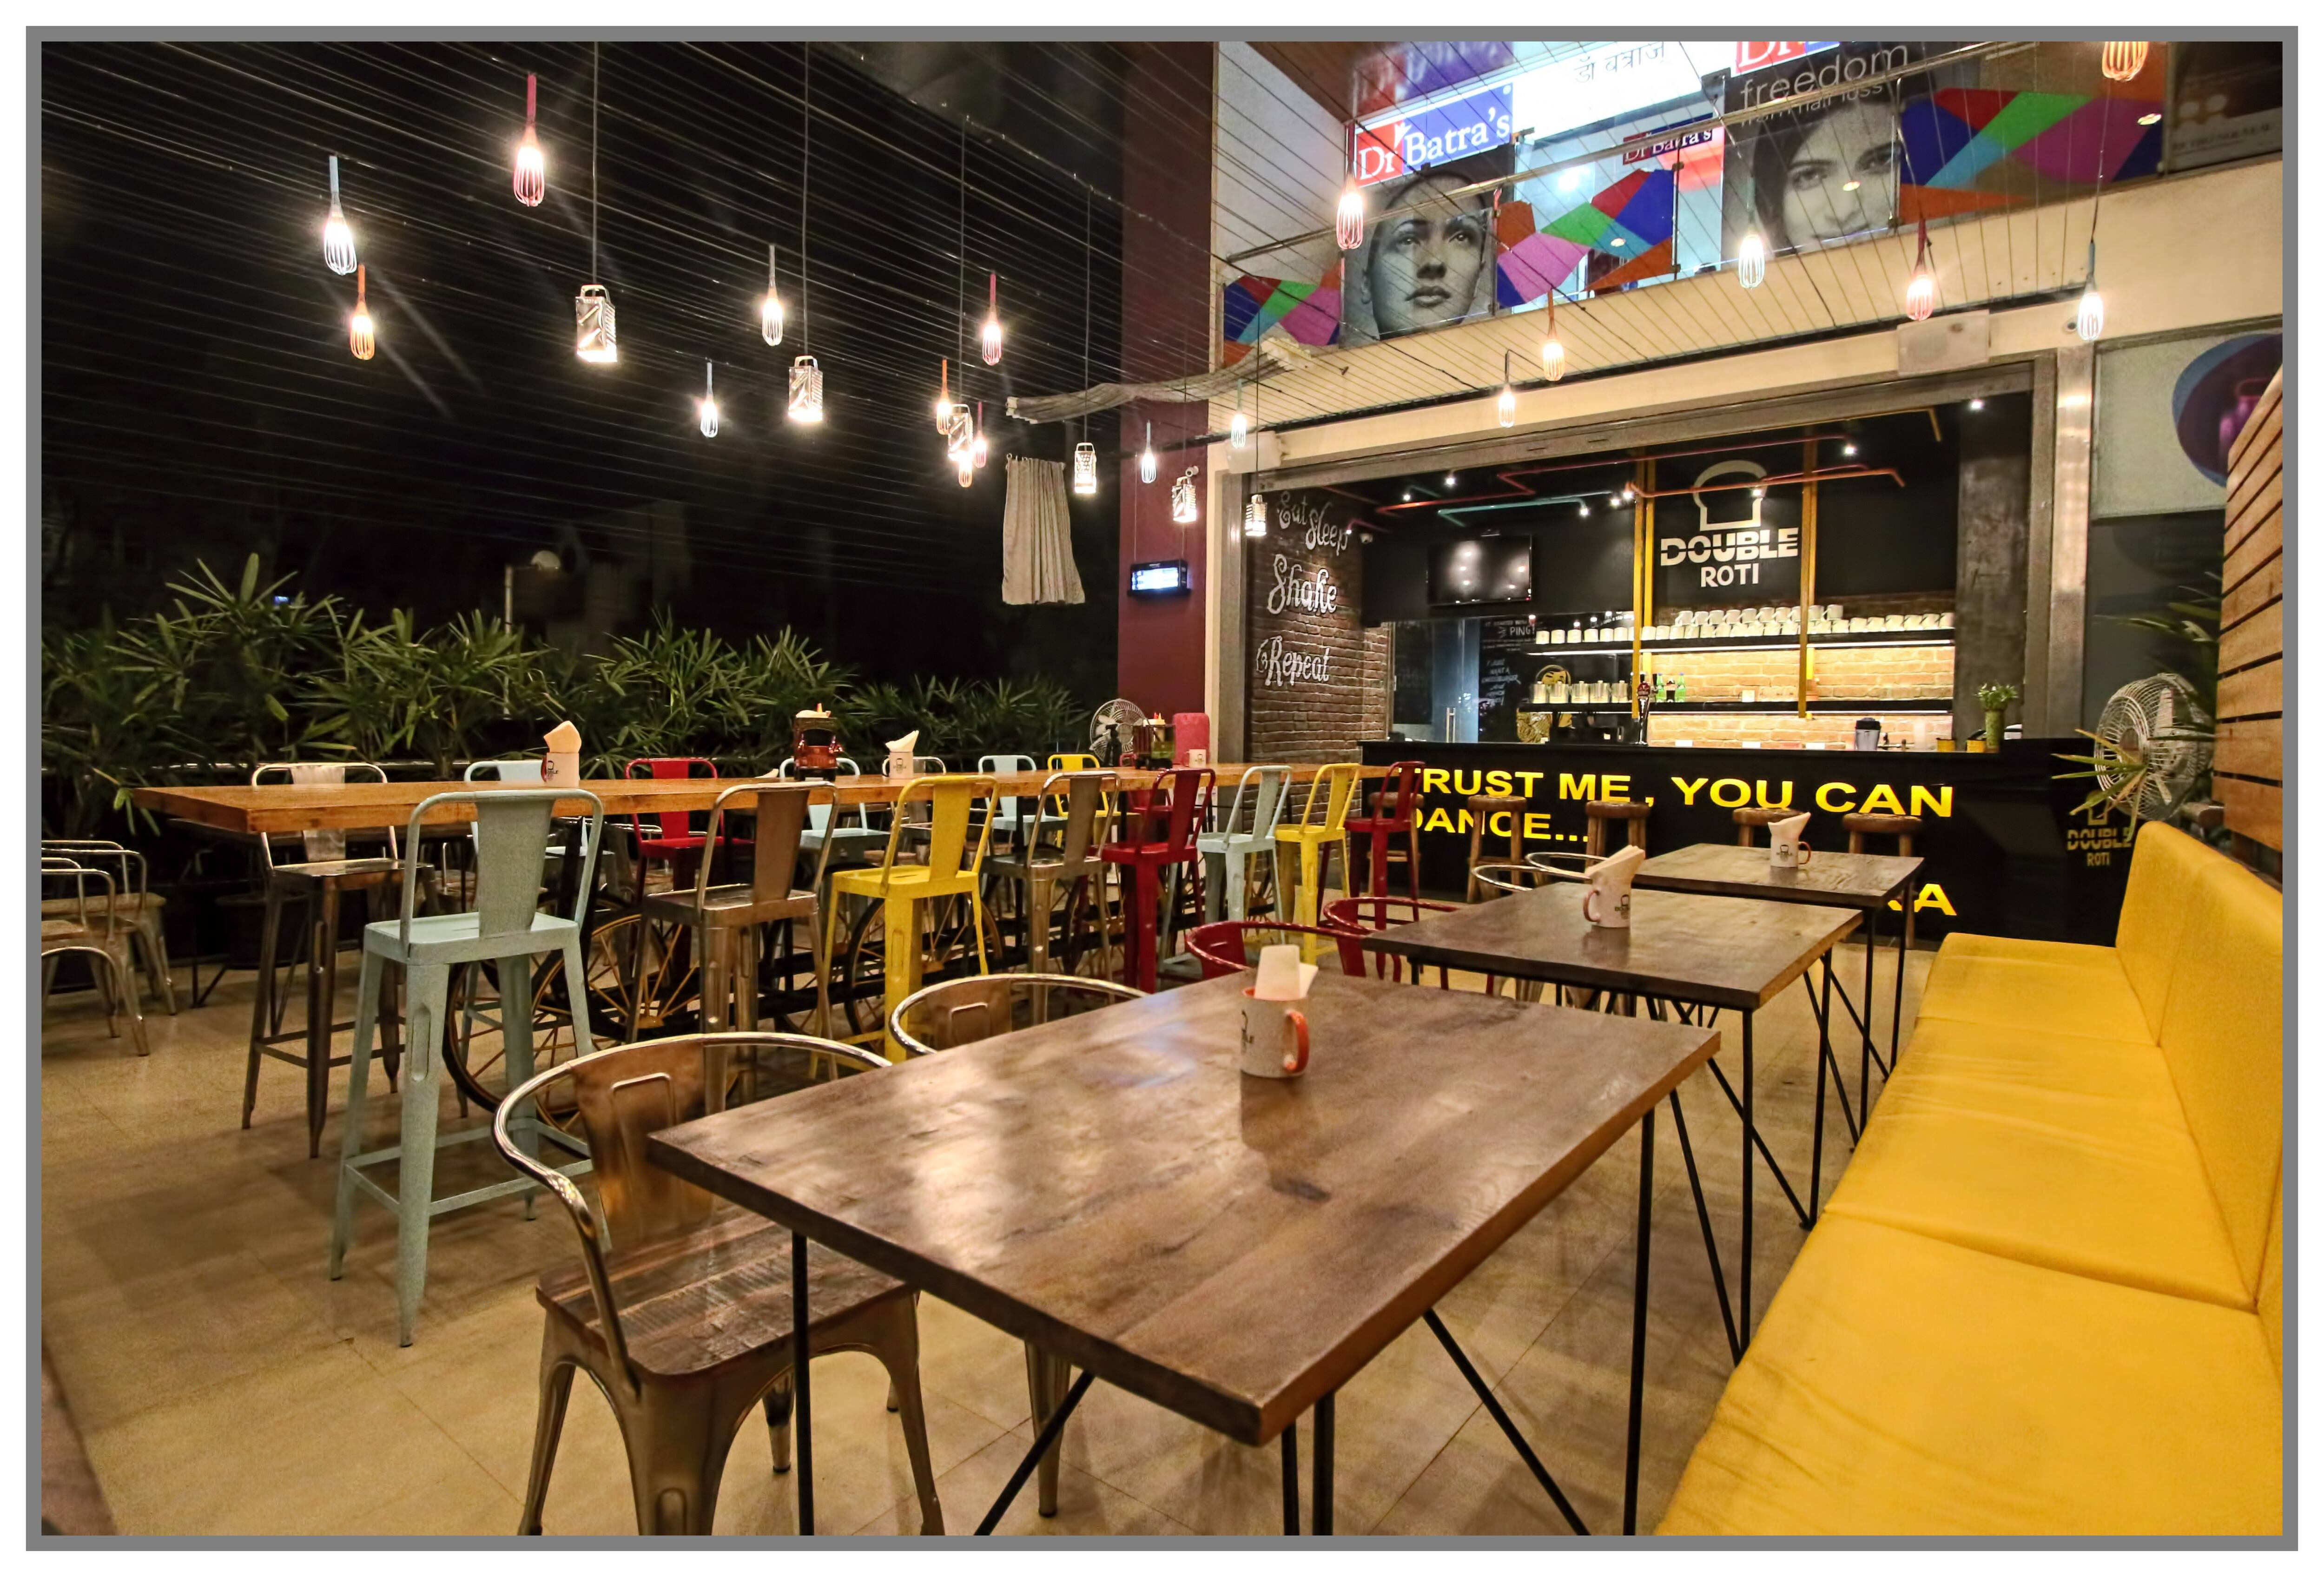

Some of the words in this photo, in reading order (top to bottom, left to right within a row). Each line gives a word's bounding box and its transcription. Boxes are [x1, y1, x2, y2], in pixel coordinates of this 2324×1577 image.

[1740, 45, 1908, 109] freedom
[1359, 146, 1398, 180] Dr
[1405, 106, 1510, 165] Batra's
[1277, 491, 1307, 529] Eat
[1305, 501, 1348, 556] Sleep
[1660, 527, 1799, 566] DOUBLE
[1267, 554, 1338, 614] Shake
[1700, 562, 1759, 587] ROTI
[1510, 626, 1535, 636] PING!
[1256, 635, 1329, 686] Repeat
[1398, 767, 1544, 798] RUST
[1671, 777, 1794, 809] YOU
[1816, 782, 1953, 818] CAN
[2087, 852, 2110, 866] ROTI
